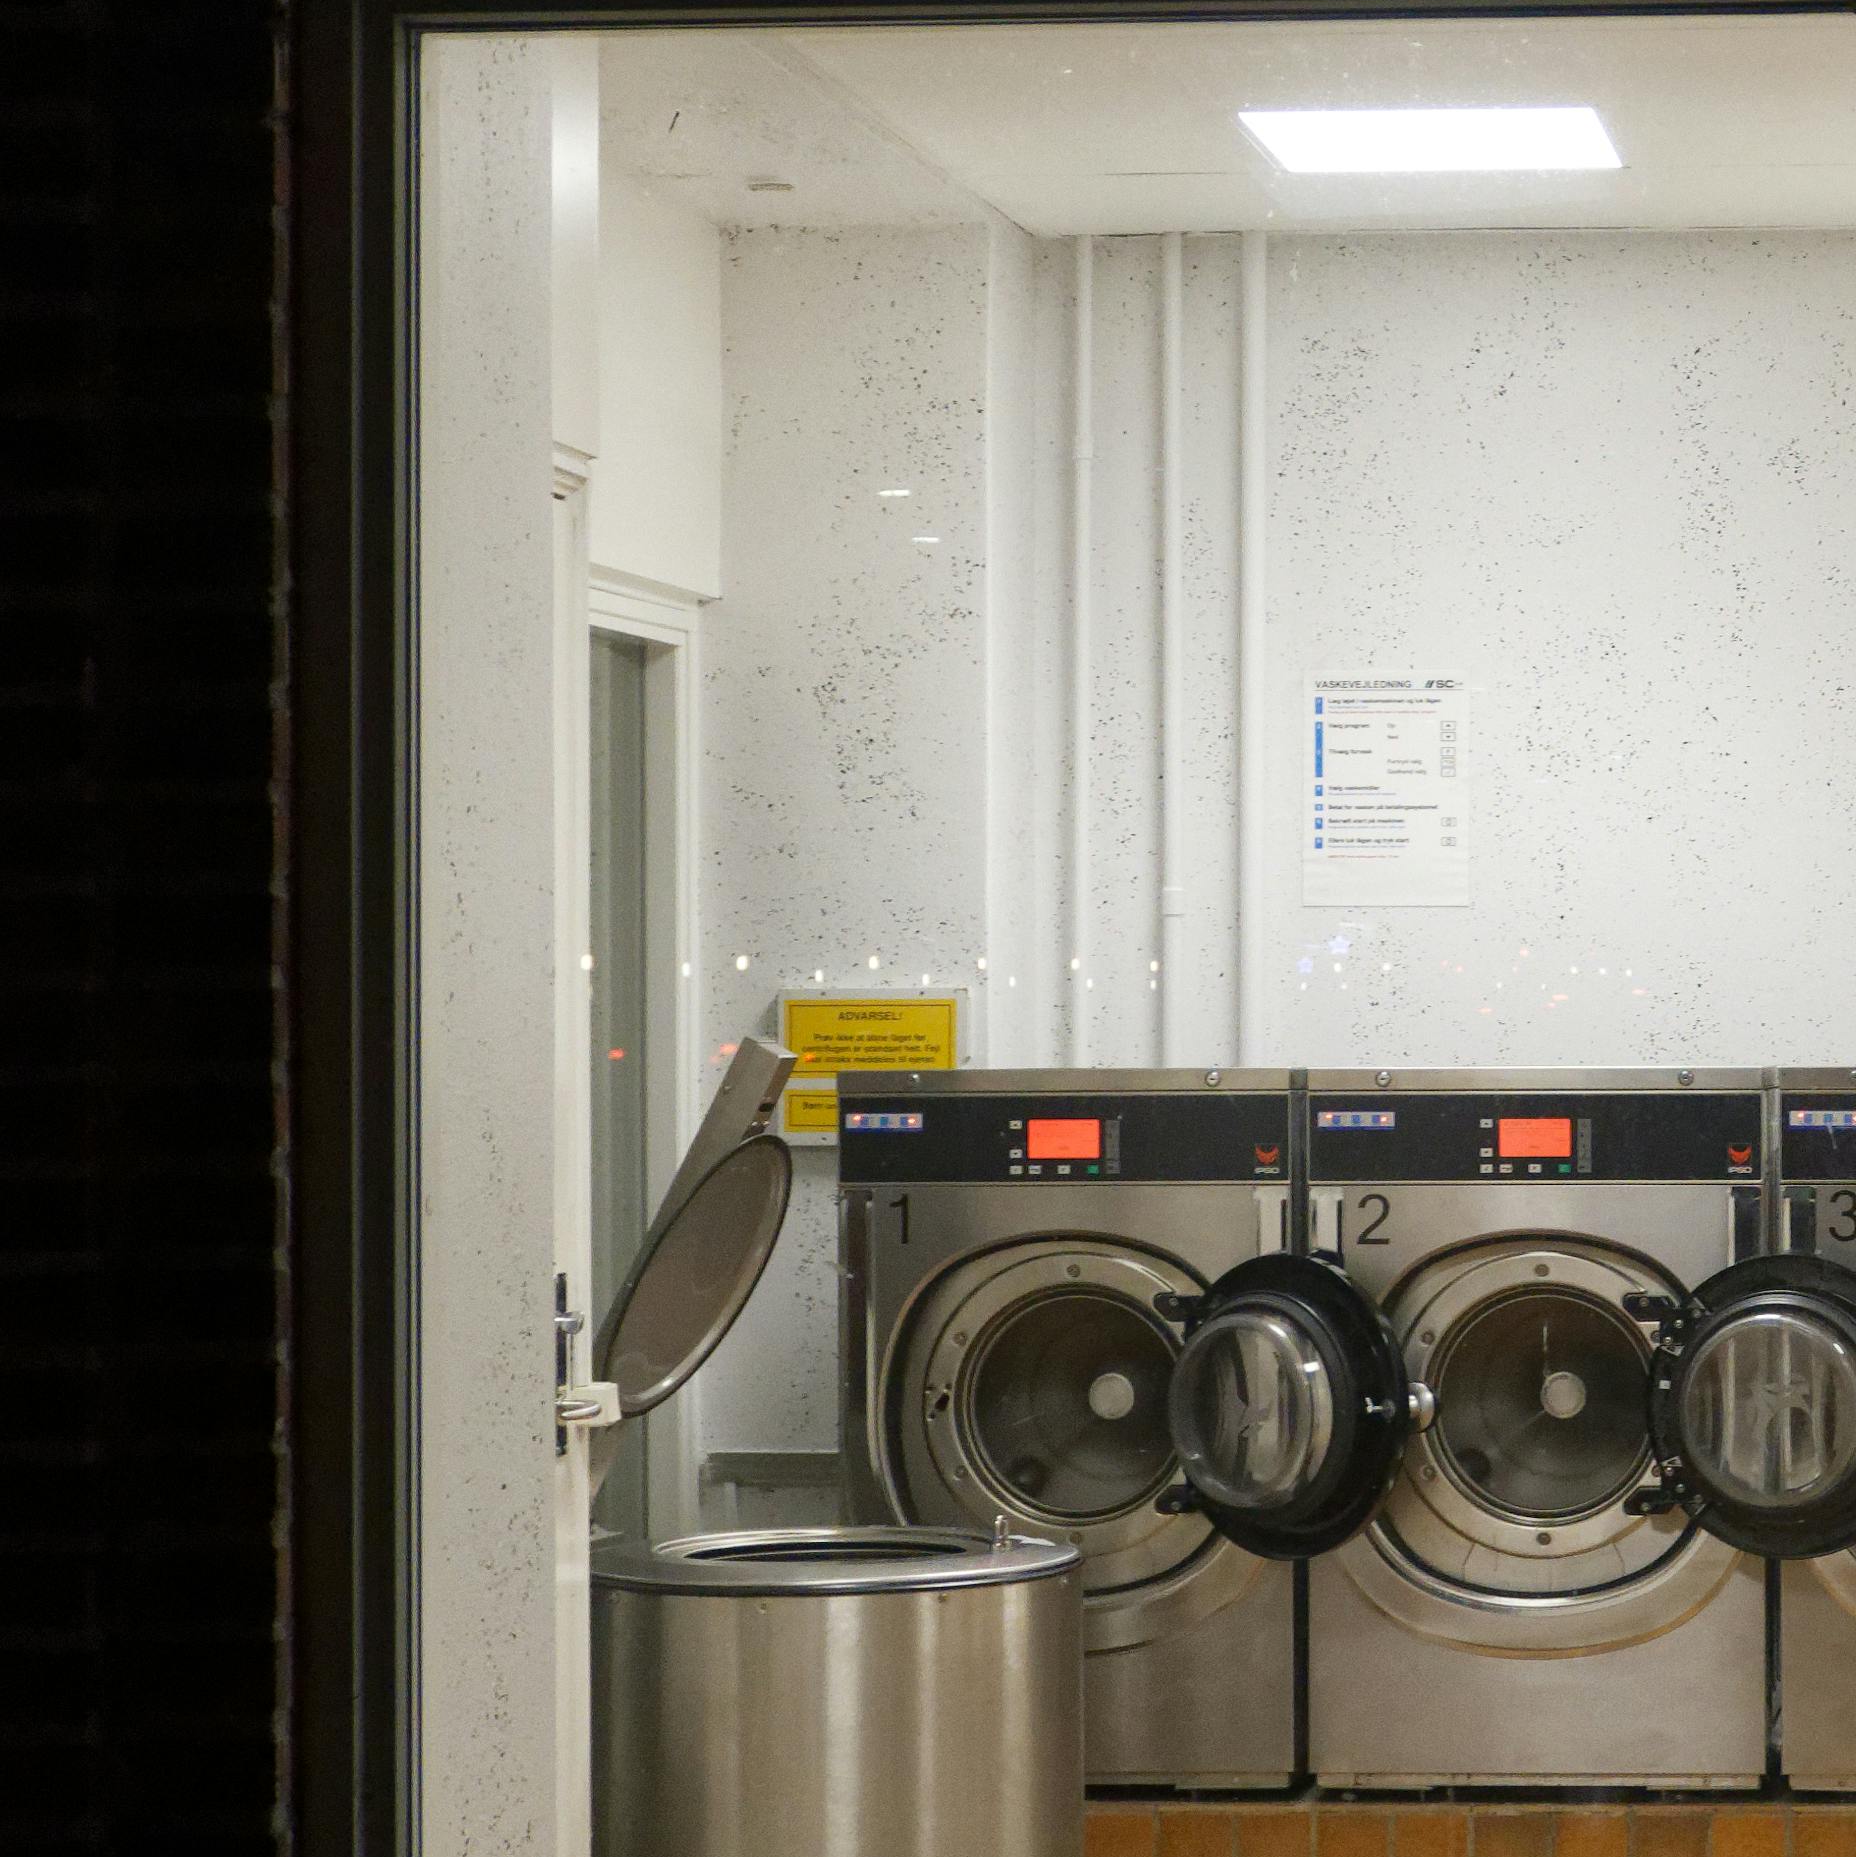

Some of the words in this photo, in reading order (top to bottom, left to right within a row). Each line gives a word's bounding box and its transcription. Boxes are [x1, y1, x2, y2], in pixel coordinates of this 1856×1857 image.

[1314, 680, 1412, 689] VASKEVEJLEDNING
[888, 1194, 910, 1244] 1
[1356, 1194, 1391, 1246] 2
